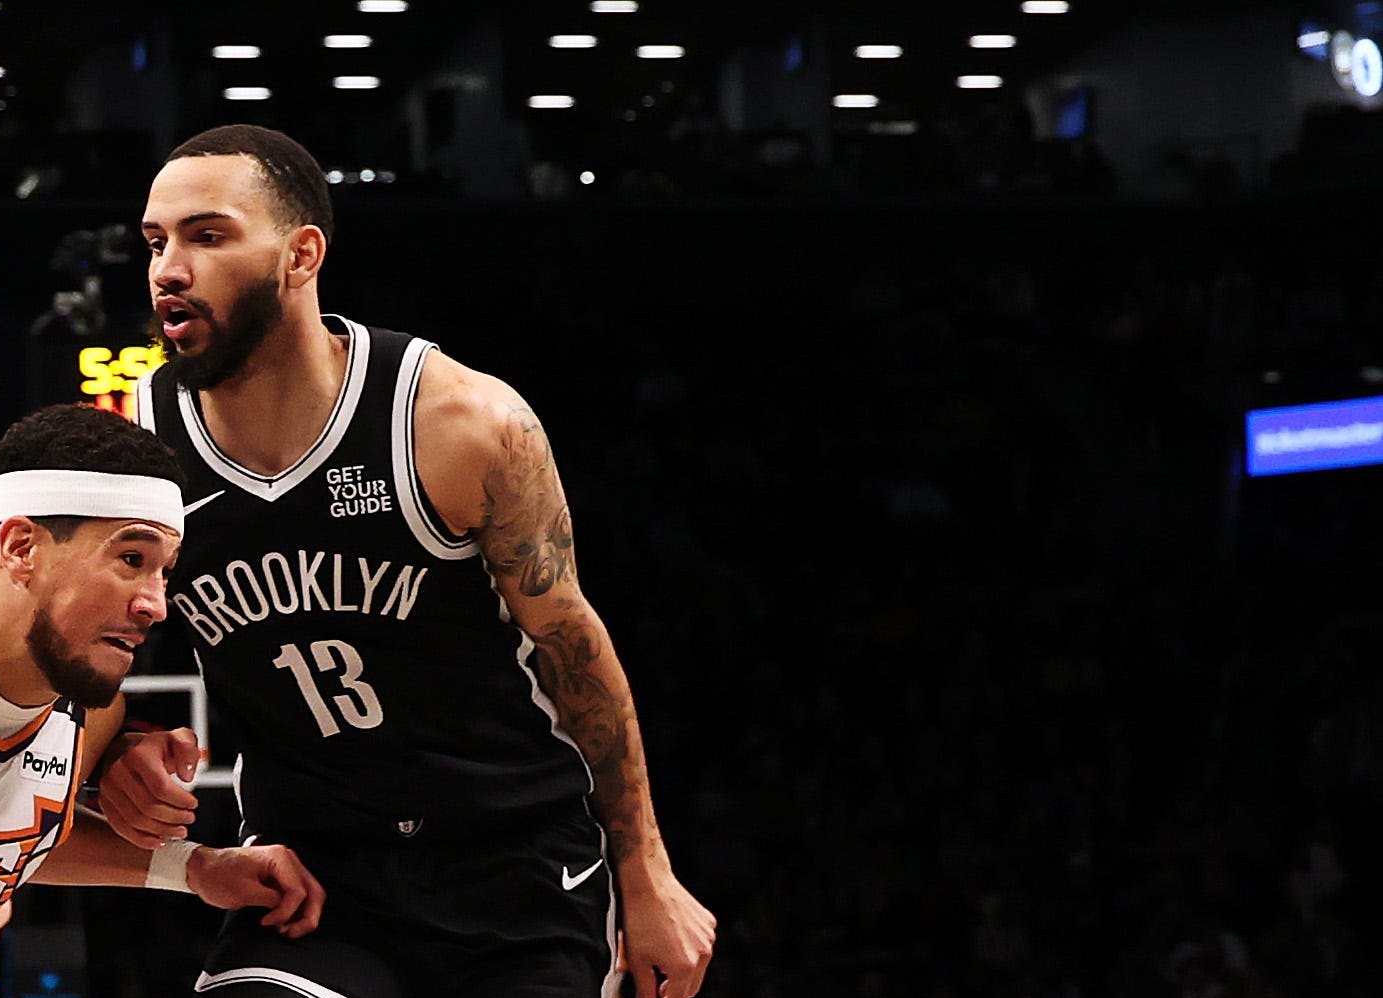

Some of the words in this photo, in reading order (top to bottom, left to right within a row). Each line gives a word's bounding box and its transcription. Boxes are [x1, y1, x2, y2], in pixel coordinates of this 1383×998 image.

[326, 465, 365, 484] GET
[328, 480, 387, 501] YOUR
[330, 496, 393, 518] GUIDE
[173, 549, 429, 647] BROOKLYN
[272, 639, 384, 738] 13
[22, 750, 68, 779] PayPal
